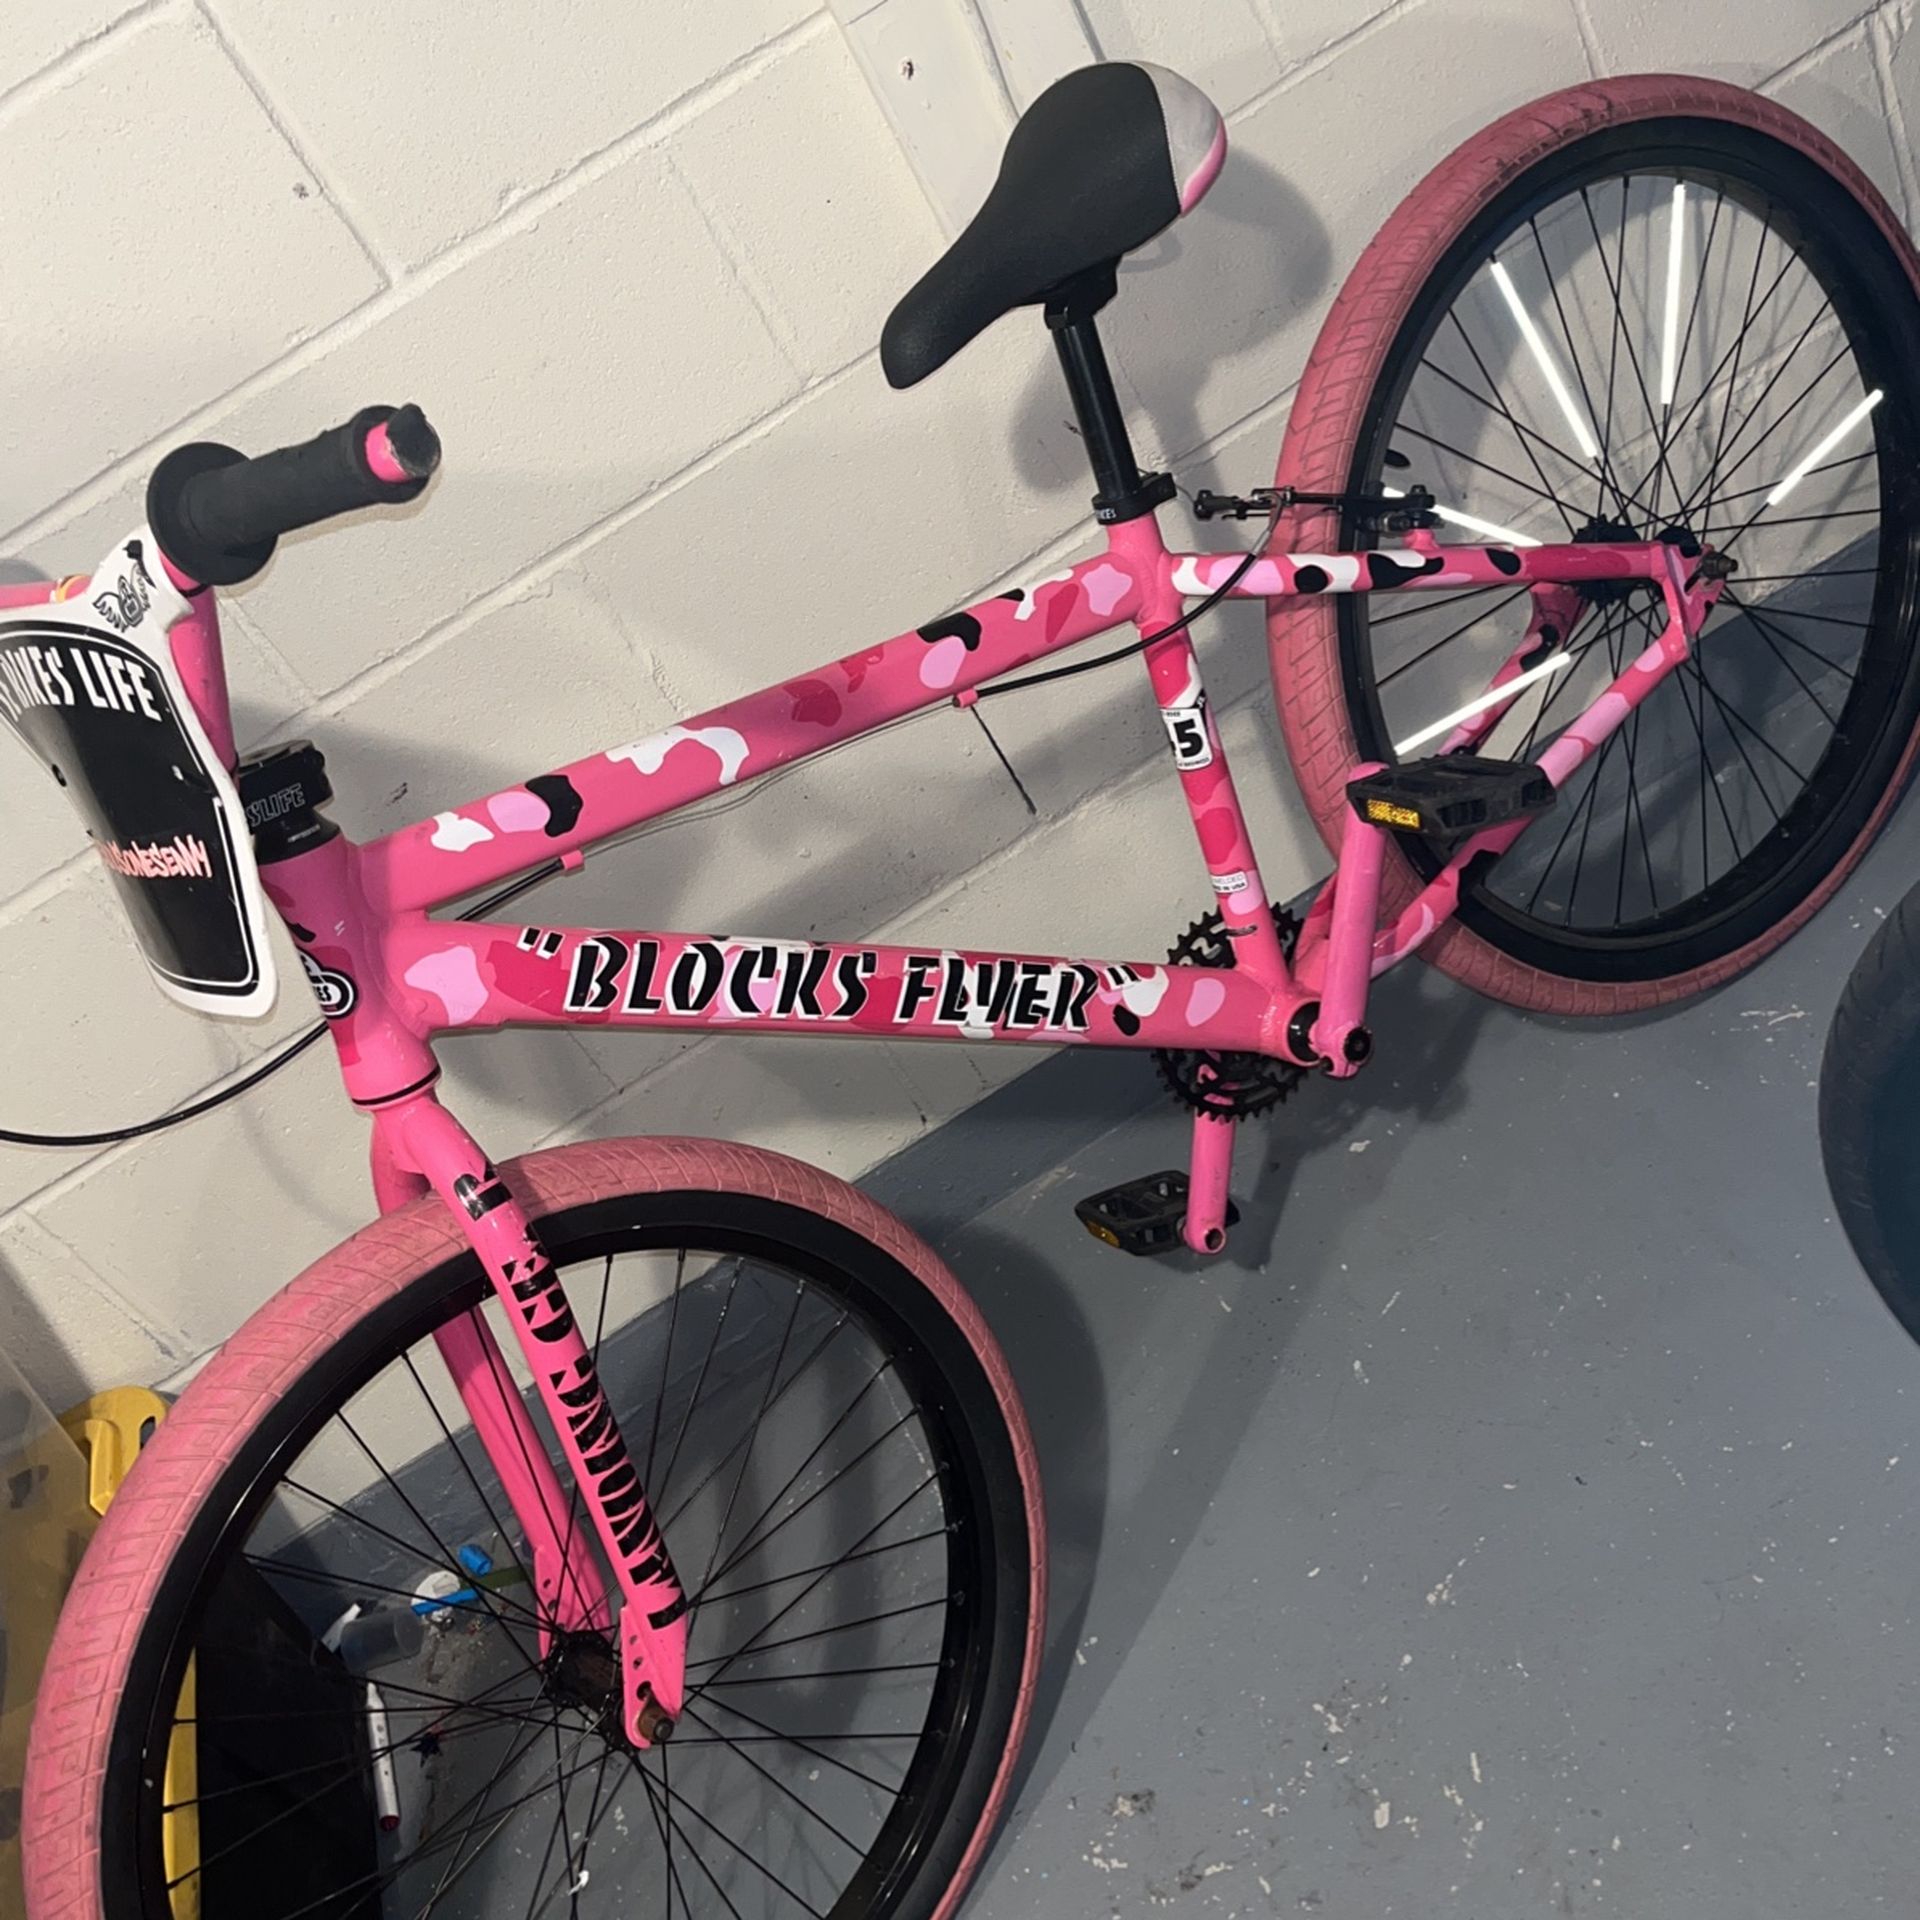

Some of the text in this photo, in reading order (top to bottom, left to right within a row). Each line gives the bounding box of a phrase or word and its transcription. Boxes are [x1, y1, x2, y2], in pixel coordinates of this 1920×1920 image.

[70, 648, 162, 722] LIFE
[1170, 718, 1204, 758] 5
[517, 927, 877, 1022] "BLOCKS
[453, 1162, 576, 1344] GER
